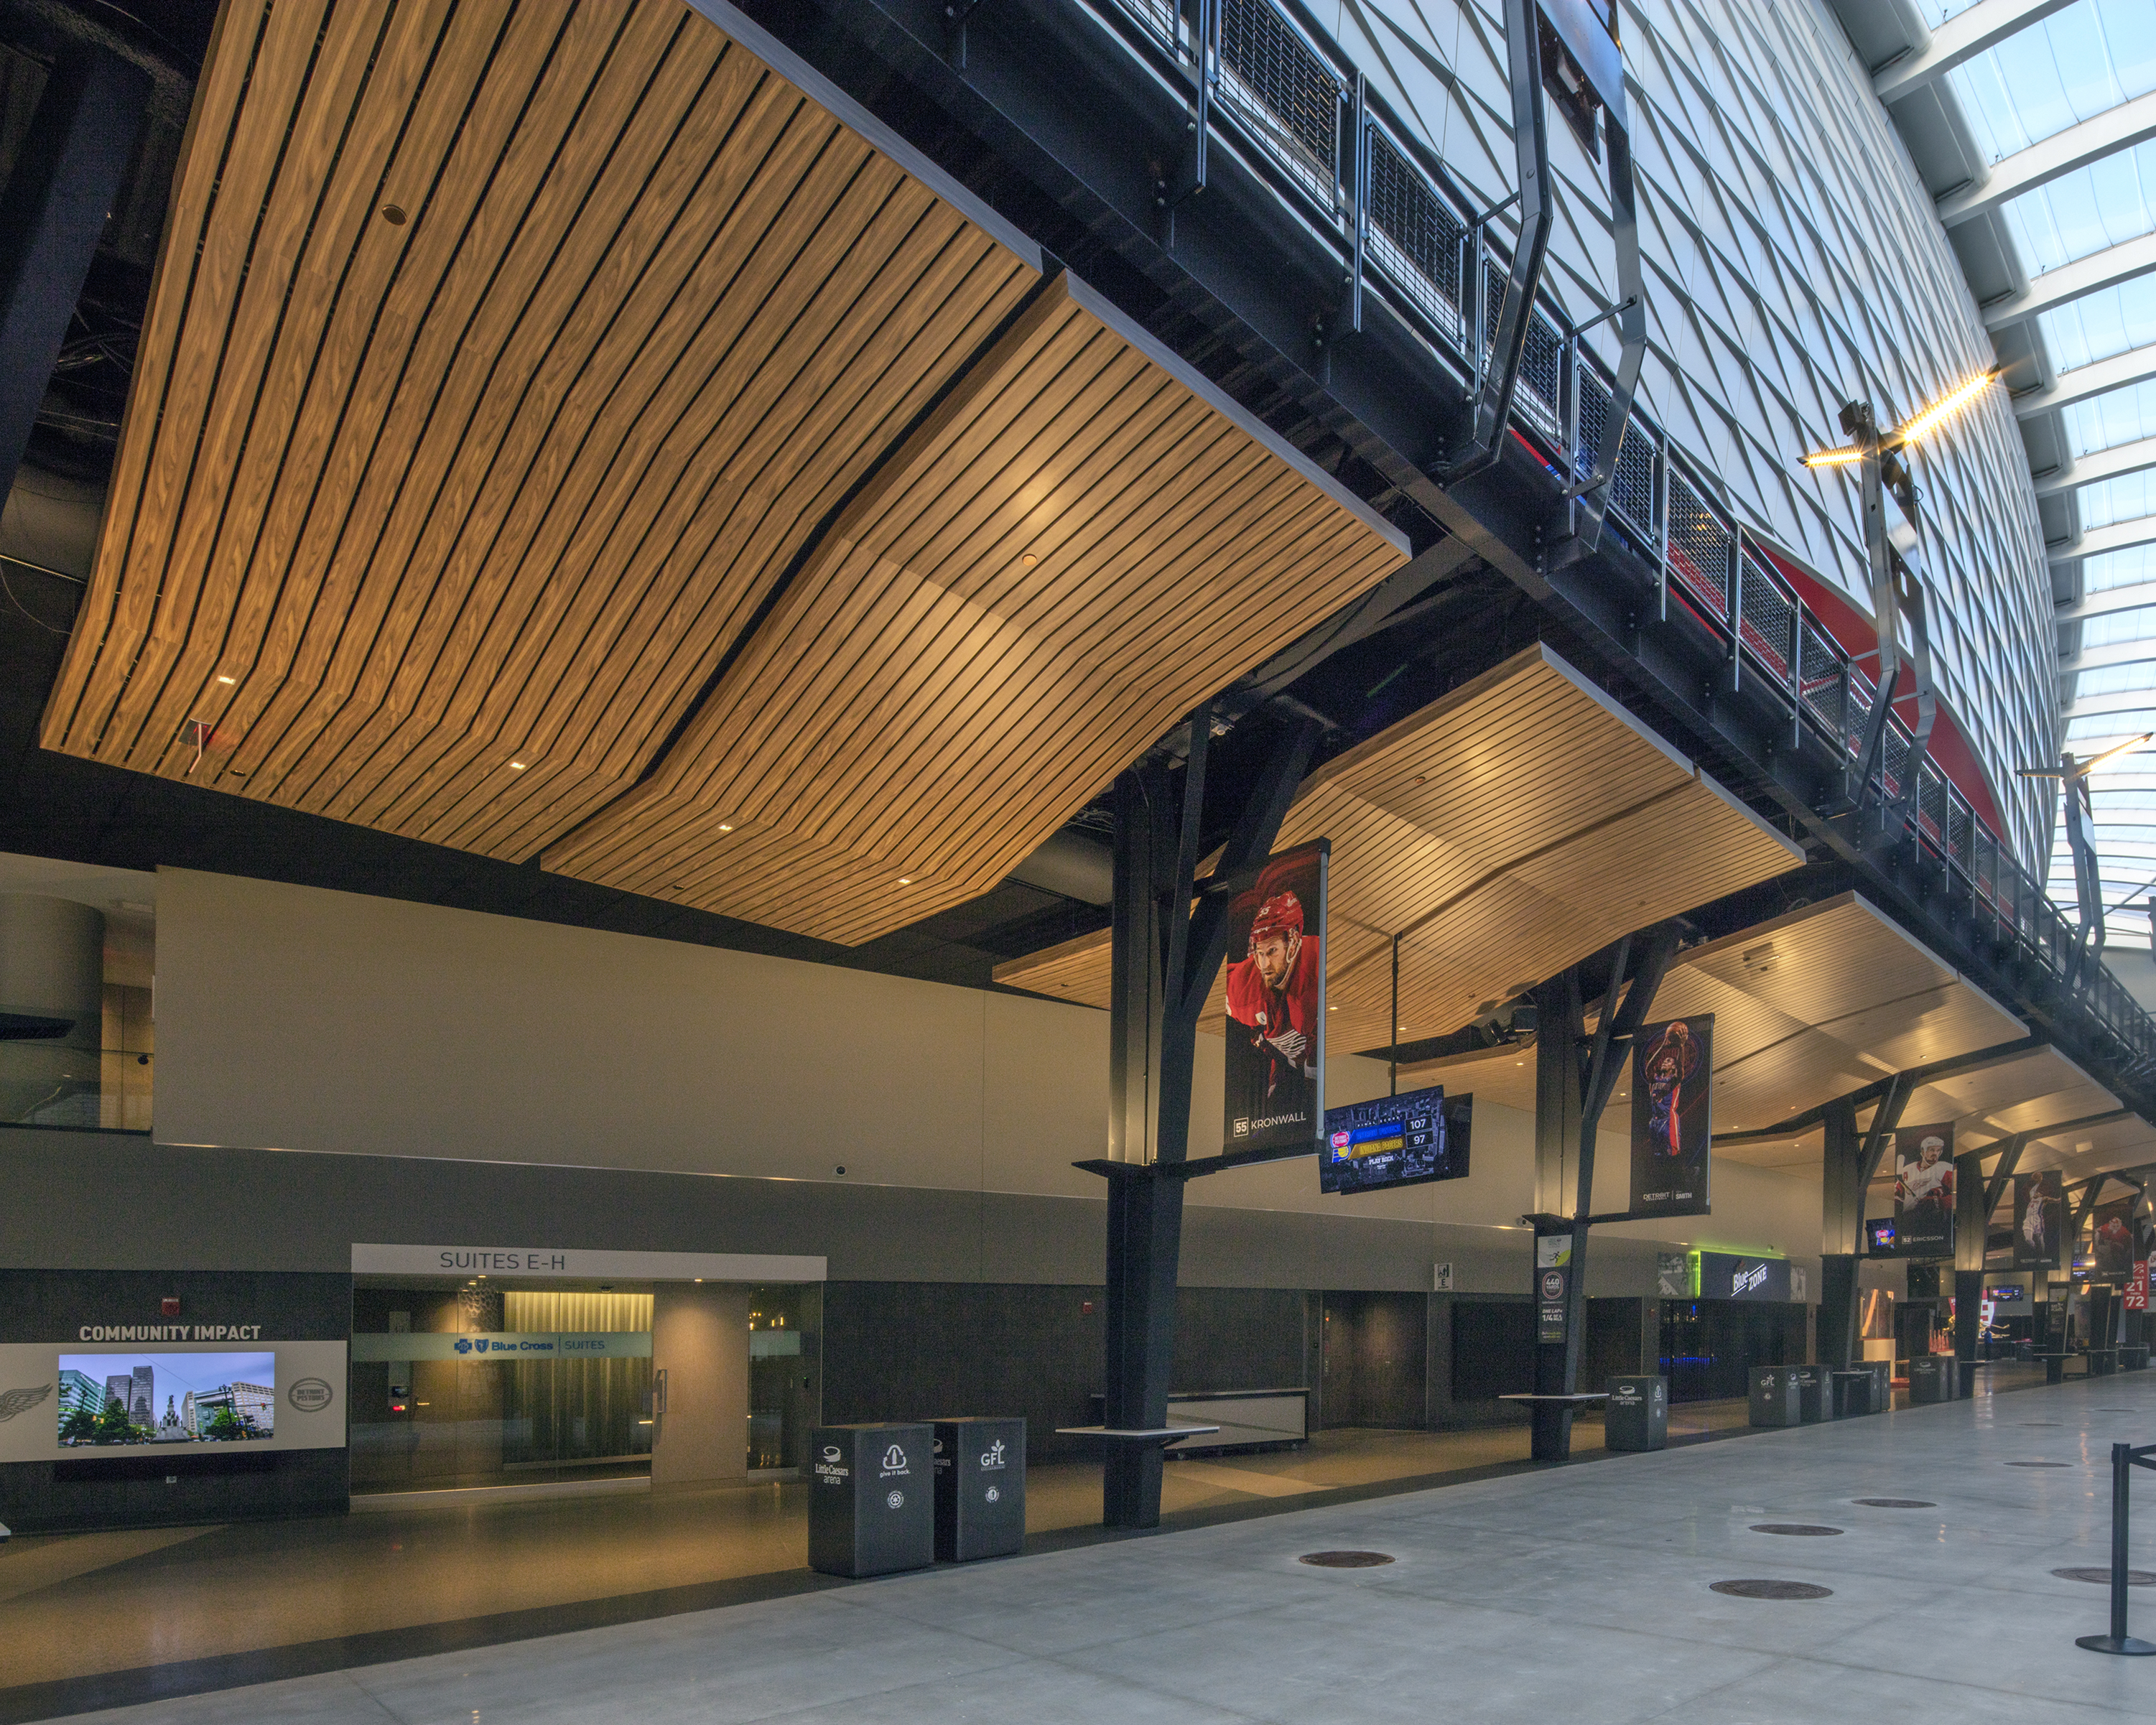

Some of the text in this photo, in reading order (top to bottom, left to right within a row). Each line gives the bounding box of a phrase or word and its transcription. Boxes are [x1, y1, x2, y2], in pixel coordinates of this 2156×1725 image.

[1236, 1112, 1306, 1133] 55 KRONWALL
[1410, 1118, 1426, 1130] 107
[1413, 1135, 1426, 1145] 97
[1360, 1138, 1403, 1155] INDIANA PACERS
[440, 1252, 564, 1270] SUITES E-H
[1733, 1266, 1767, 1292] Blue ZONE
[2127, 1280, 2143, 1292] 21
[2126, 1296, 2145, 1307] 72
[80, 1325, 261, 1341] COMMUNITY IMPACT
[491, 1341, 605, 1352] Blue Cross SUITES
[1760, 1377, 1775, 1386] GFL
[981, 1449, 1005, 1466] GFL
[823, 1476, 841, 1484] arena
